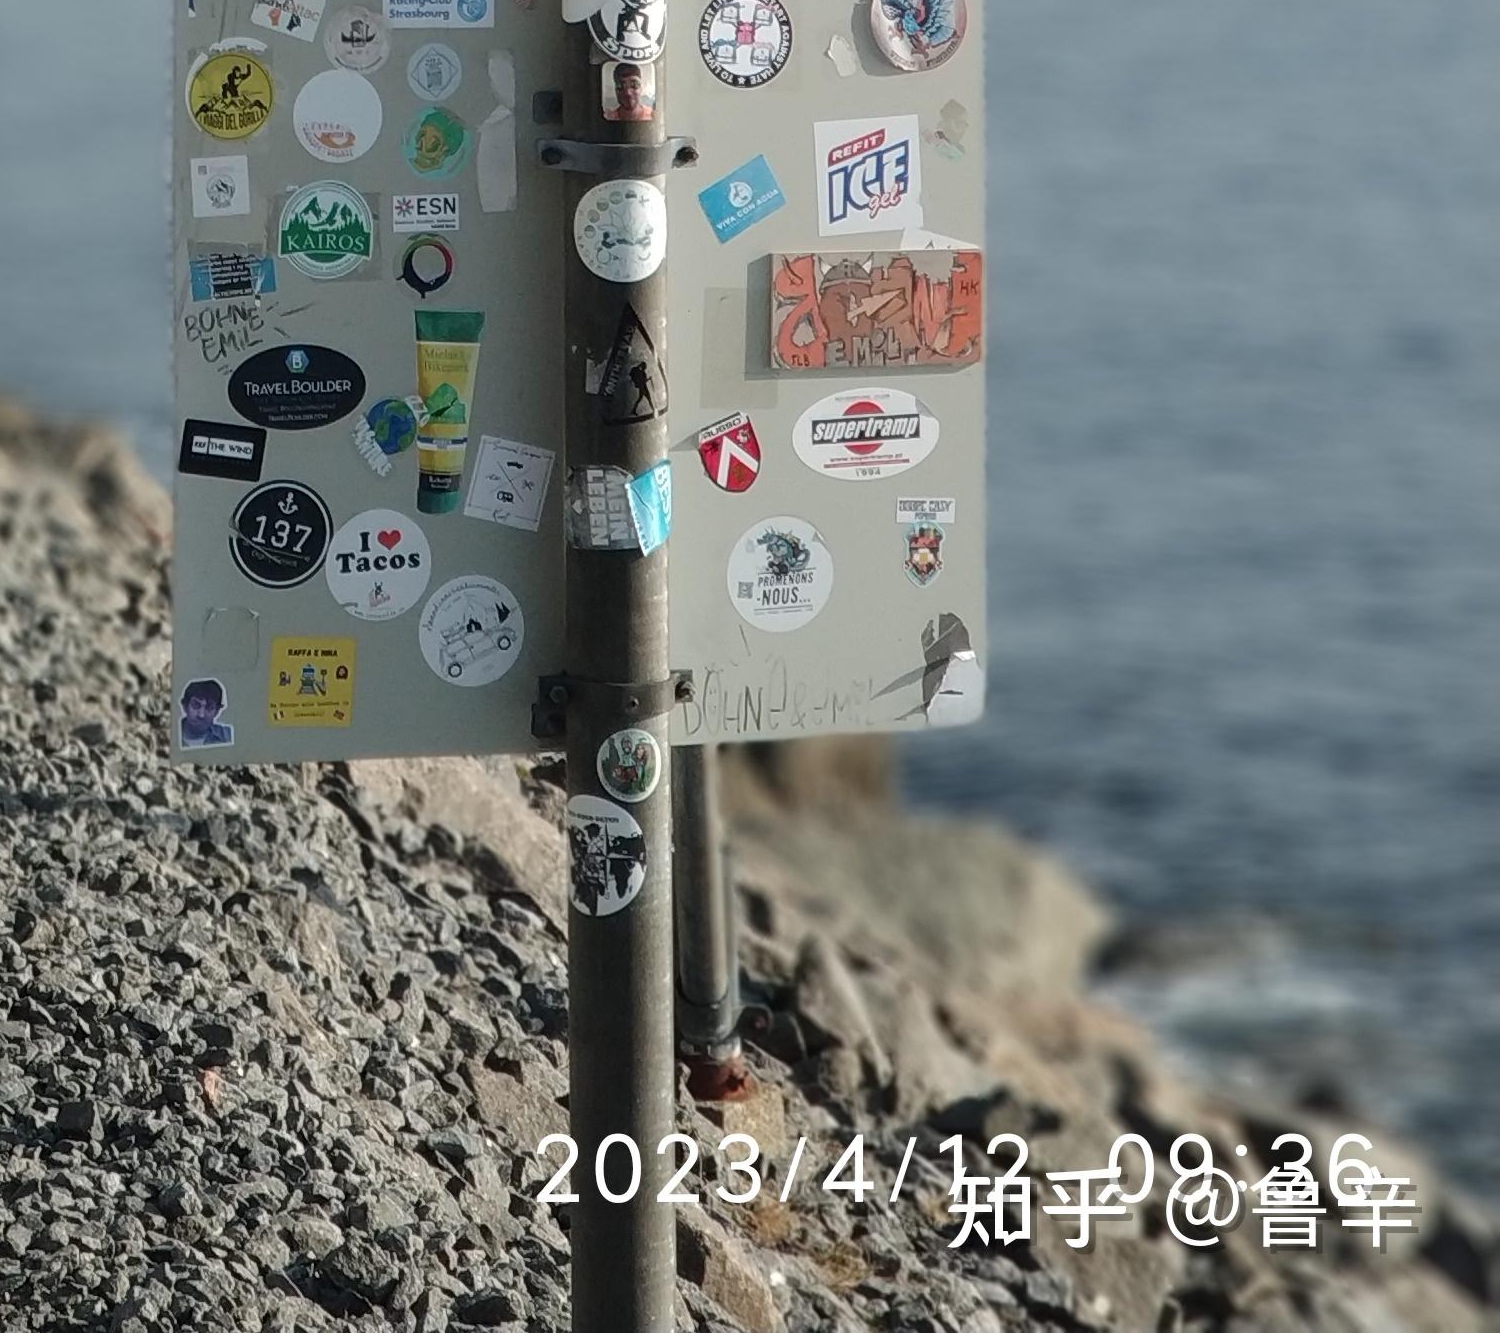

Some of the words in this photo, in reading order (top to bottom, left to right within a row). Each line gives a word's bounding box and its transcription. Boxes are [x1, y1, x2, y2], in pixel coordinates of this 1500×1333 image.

[388, 7, 450, 21] Strasbourg
[779, 31, 790, 68] AGAINST
[750, 63, 776, 85] HATE
[225, 114, 239, 130] DEL
[831, 135, 880, 162] REFIT
[828, 139, 910, 224] ICE
[416, 197, 457, 215] ESN
[715, 214, 737, 230] VIVA
[737, 204, 757, 219] CON
[754, 188, 780, 210] AGUA
[868, 183, 901, 219] gel
[287, 233, 366, 251] KAIROS
[813, 415, 920, 442] supertramp
[228, 444, 253, 456] WIND
[252, 515, 313, 554] 137
[358, 531, 371, 552] I
[336, 550, 421, 574] Tacos
[757, 572, 815, 587] PROMENONS
